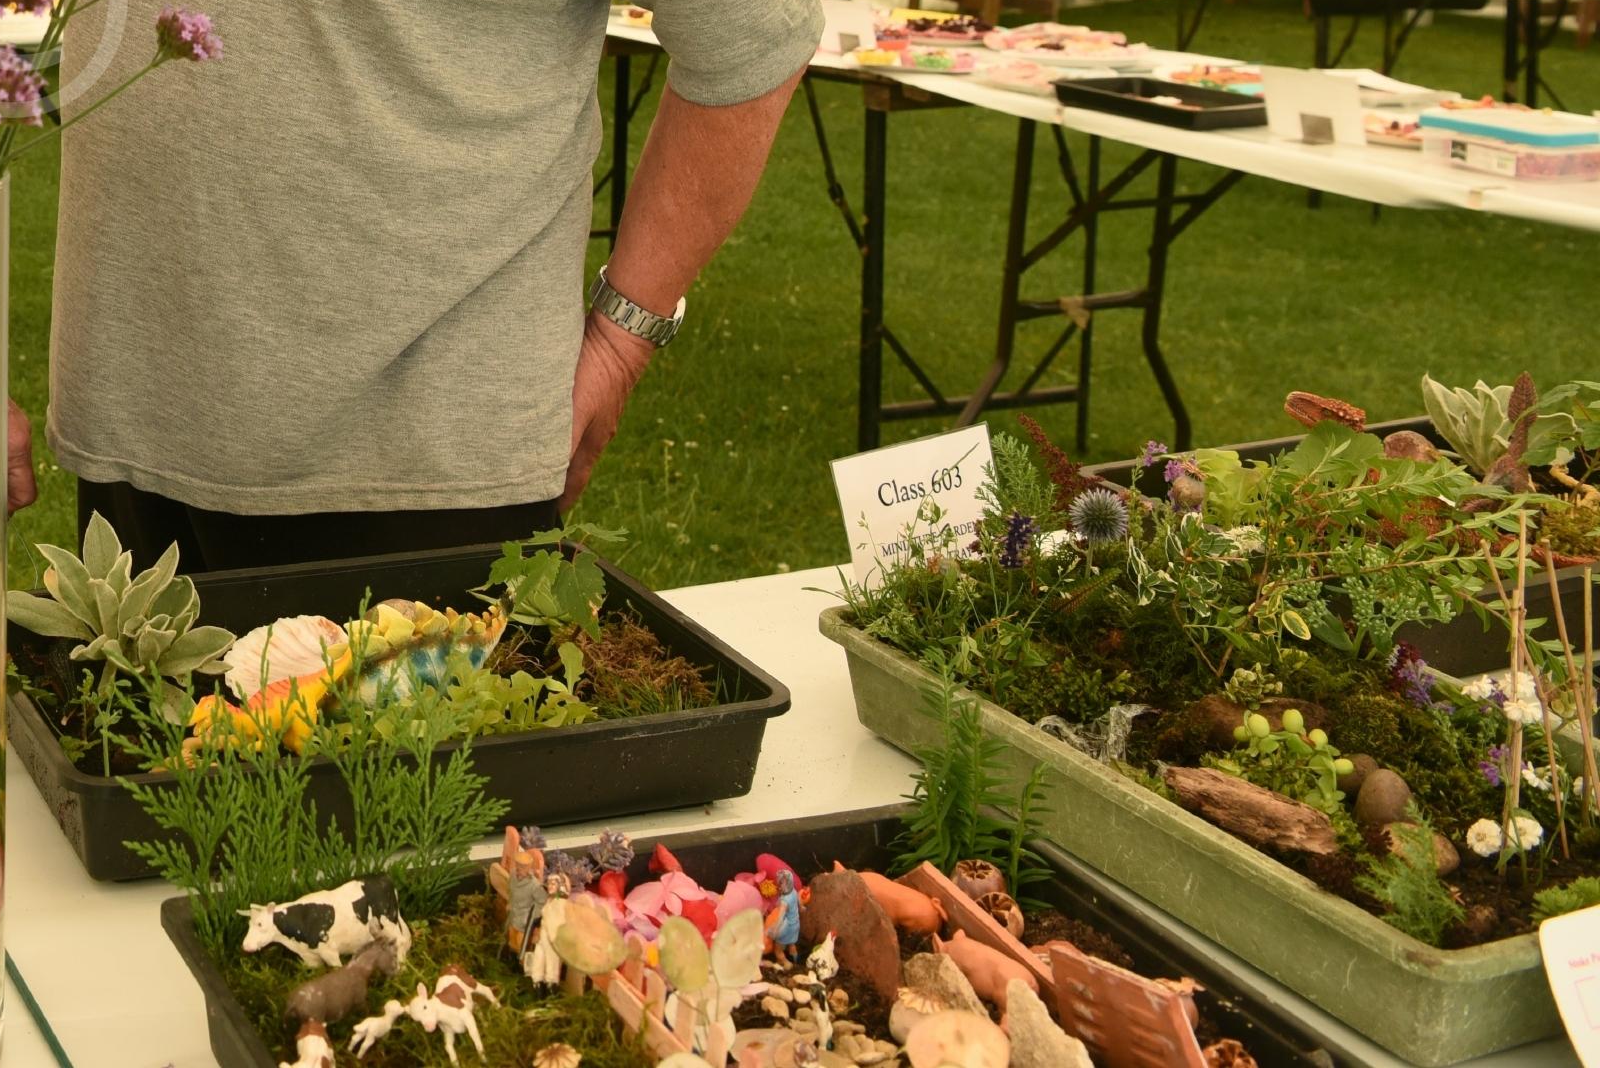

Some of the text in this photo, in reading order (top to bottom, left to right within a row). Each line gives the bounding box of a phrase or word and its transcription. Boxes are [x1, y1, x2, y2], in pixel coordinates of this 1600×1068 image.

[877, 465, 962, 507] Class 603
[881, 531, 939, 557] MINITURE
